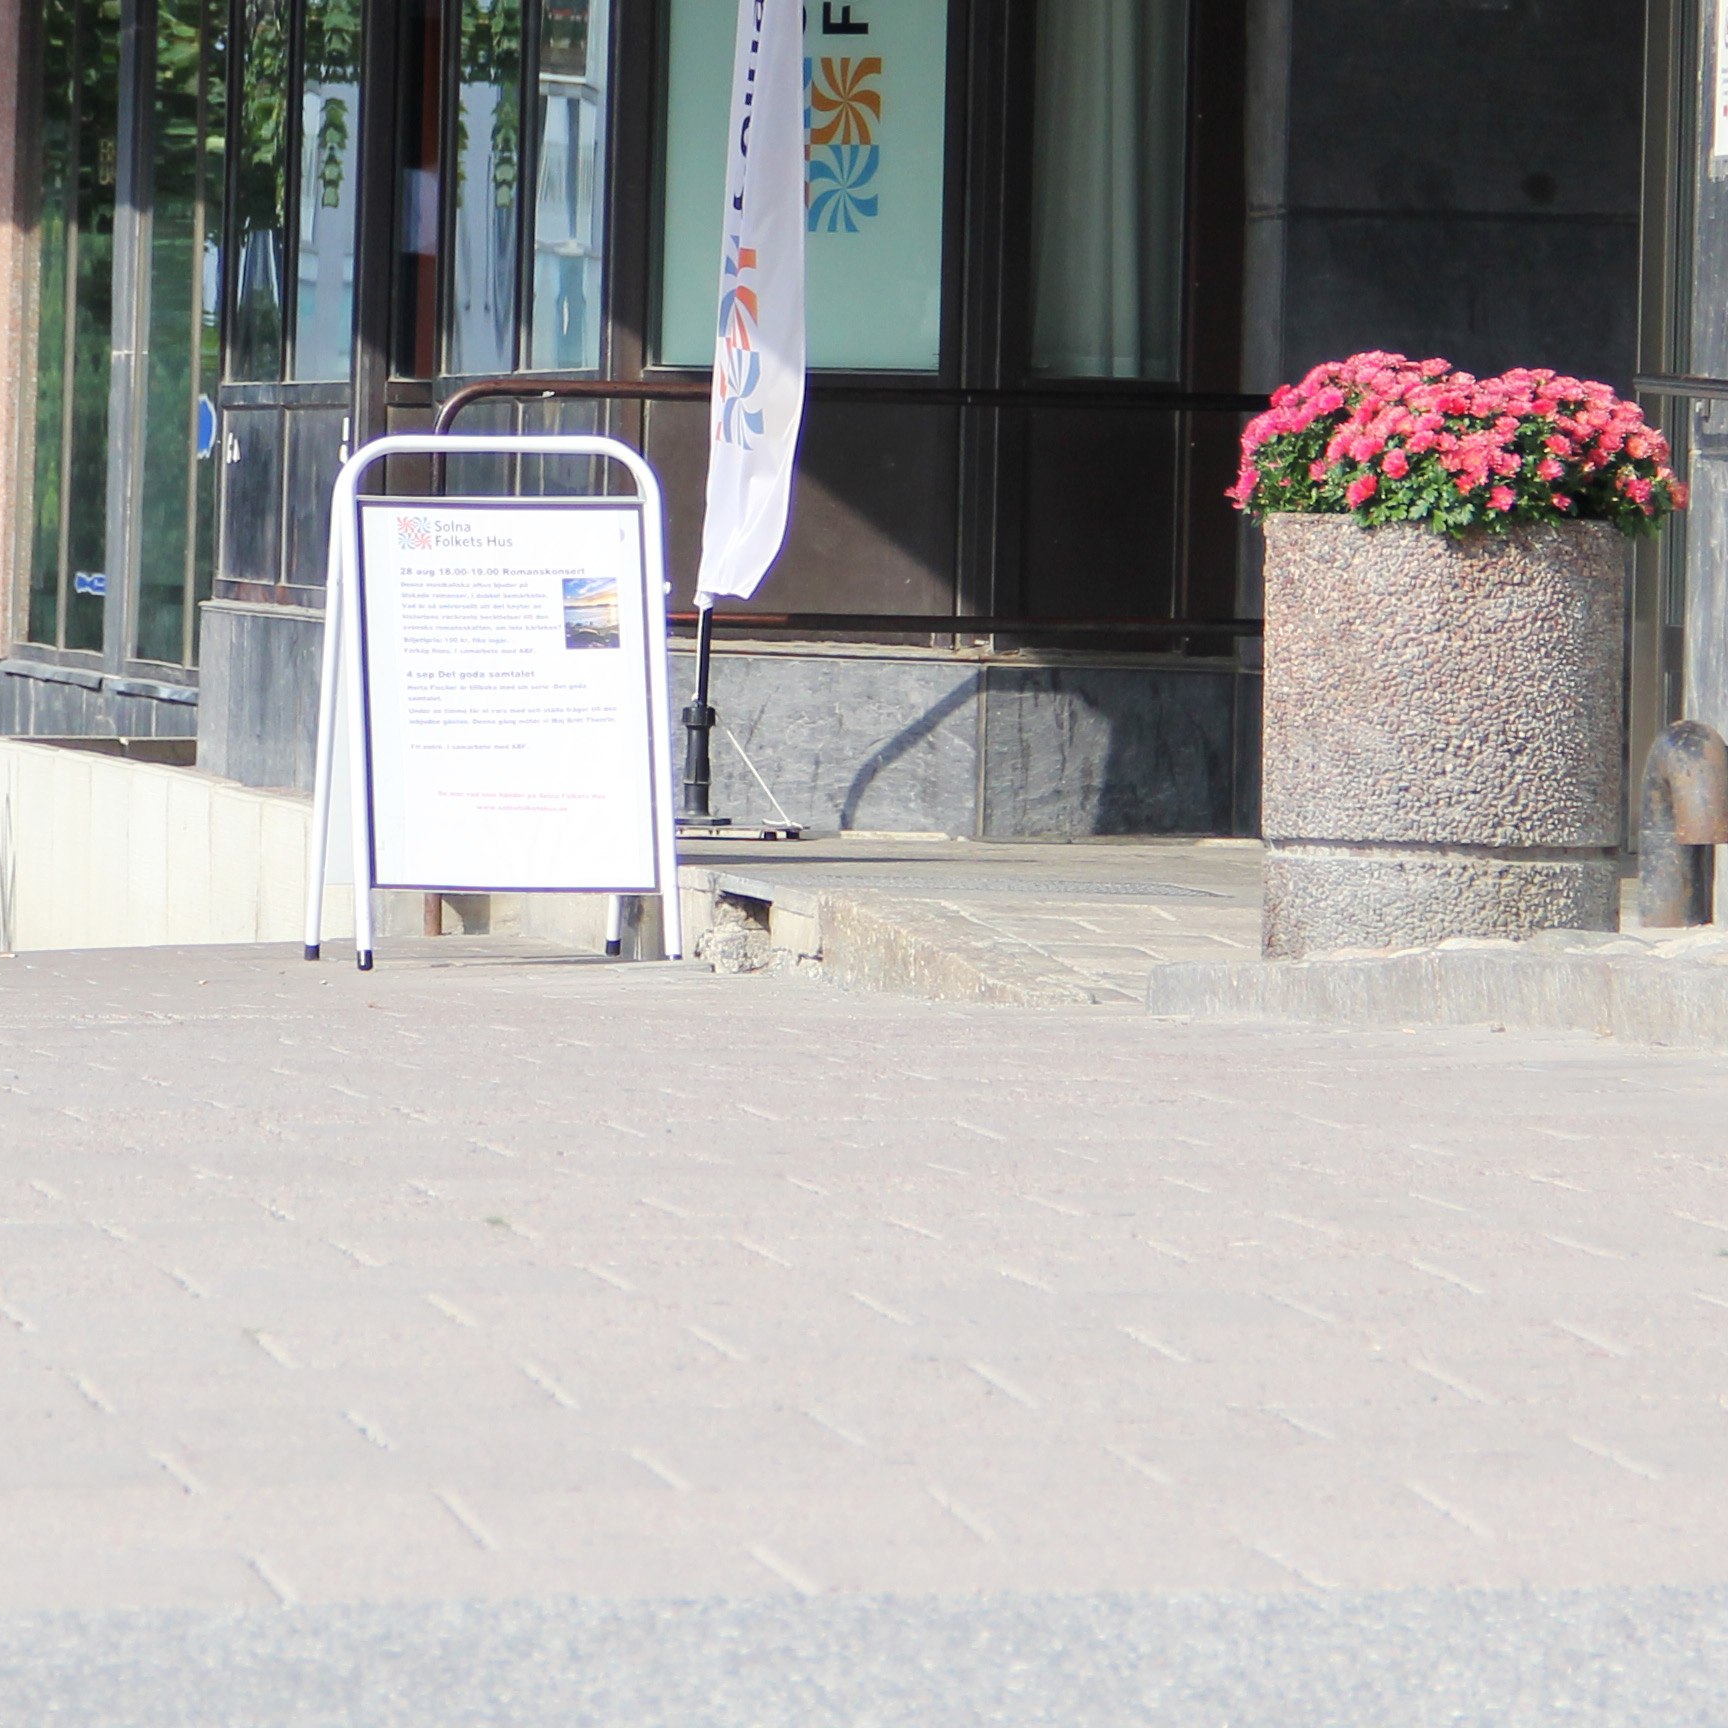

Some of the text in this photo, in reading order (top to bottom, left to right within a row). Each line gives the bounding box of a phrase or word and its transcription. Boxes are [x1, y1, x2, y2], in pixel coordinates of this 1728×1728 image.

[434, 520, 471, 533] Solna
[435, 535, 514, 548] Folkets Hus
[416, 569, 435, 578] aug
[502, 567, 586, 576] Romanskonsert
[406, 670, 536, 680] 4 sep Det goda samtalet
